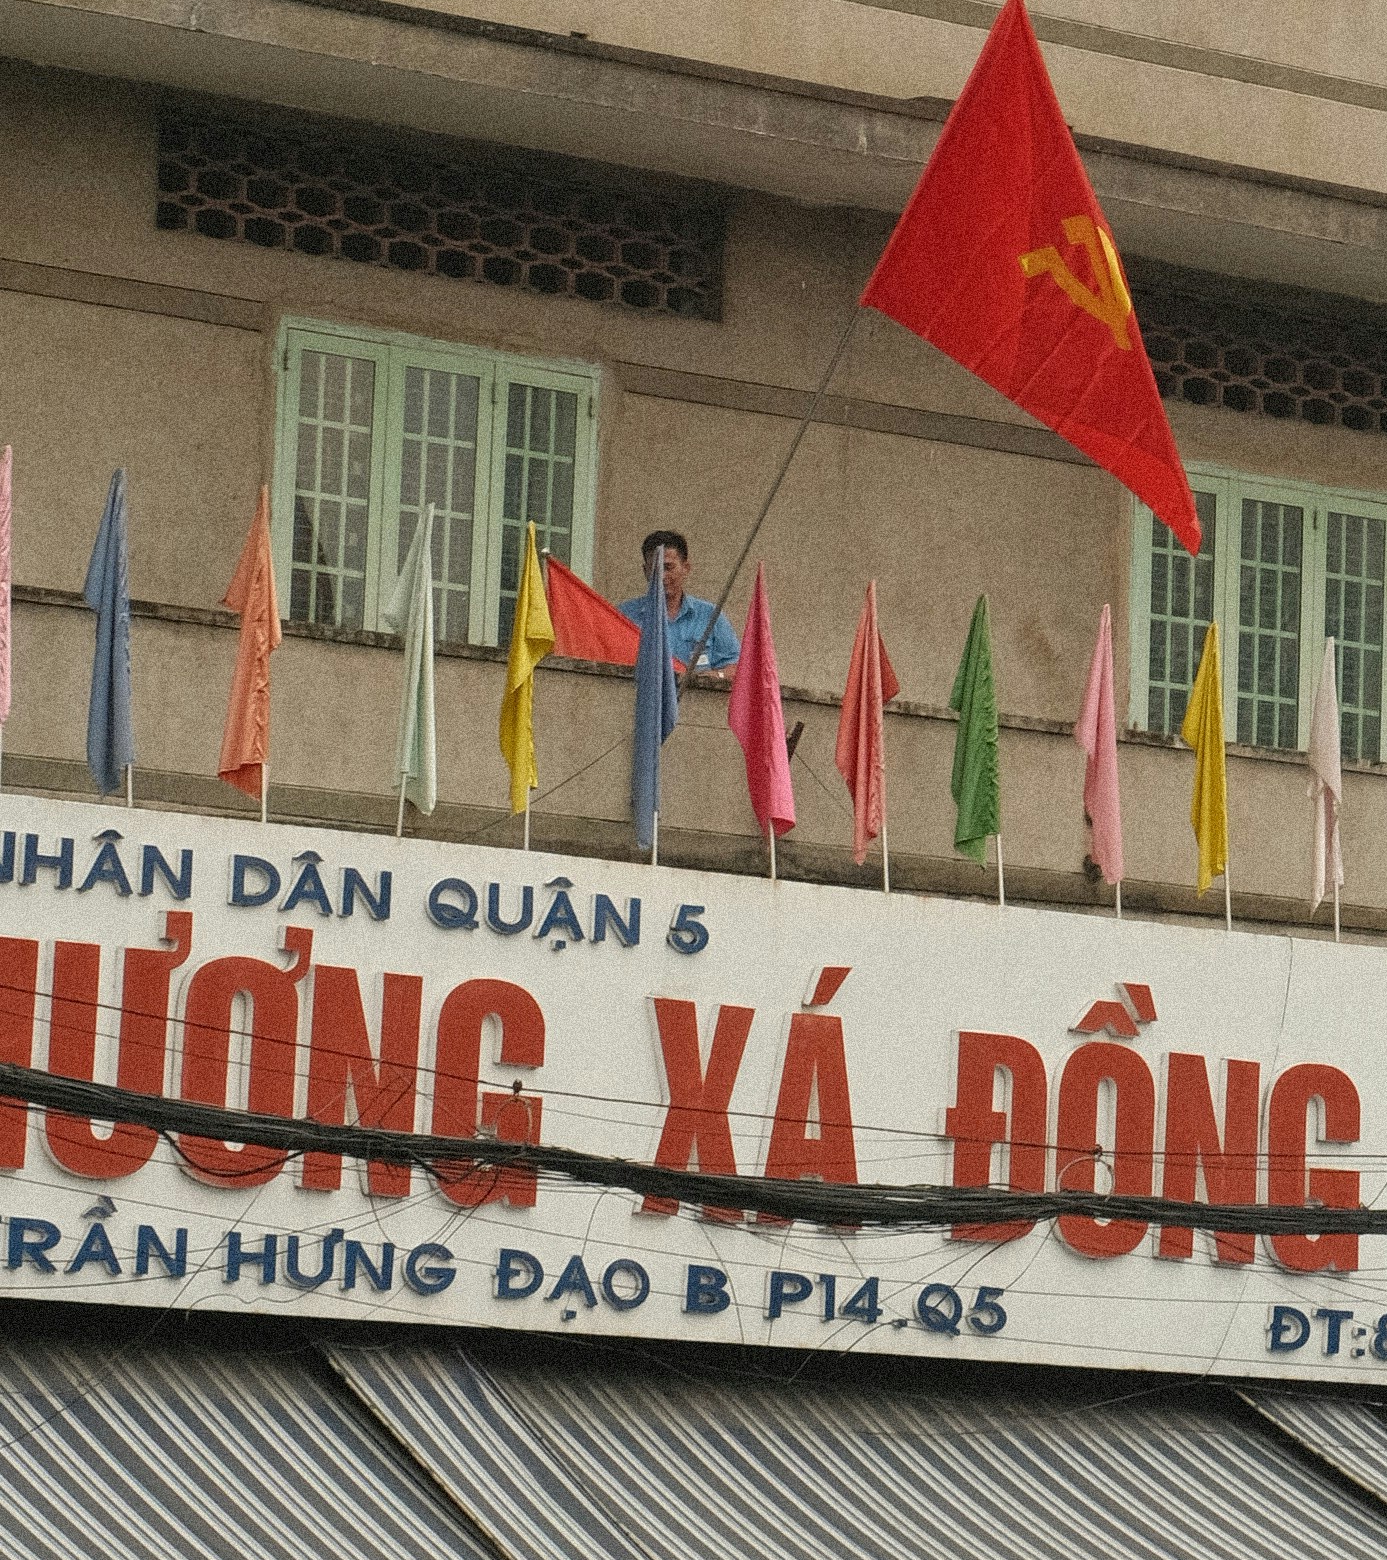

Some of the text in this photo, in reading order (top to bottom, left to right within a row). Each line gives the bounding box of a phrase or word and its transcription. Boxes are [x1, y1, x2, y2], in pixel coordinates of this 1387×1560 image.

[228, 850, 393, 921] DÂN
[427, 876, 641, 951] QUẬN
[667, 904, 709, 956] 5
[634, 966, 861, 1235] XÁ
[944, 982, 1361, 1273] ĐỒNG
[0, 1195, 188, 1278] RẦN
[225, 1228, 457, 1295] HƯNG
[494, 1248, 650, 1321] ĐẠO
[682, 1264, 731, 1314] B
